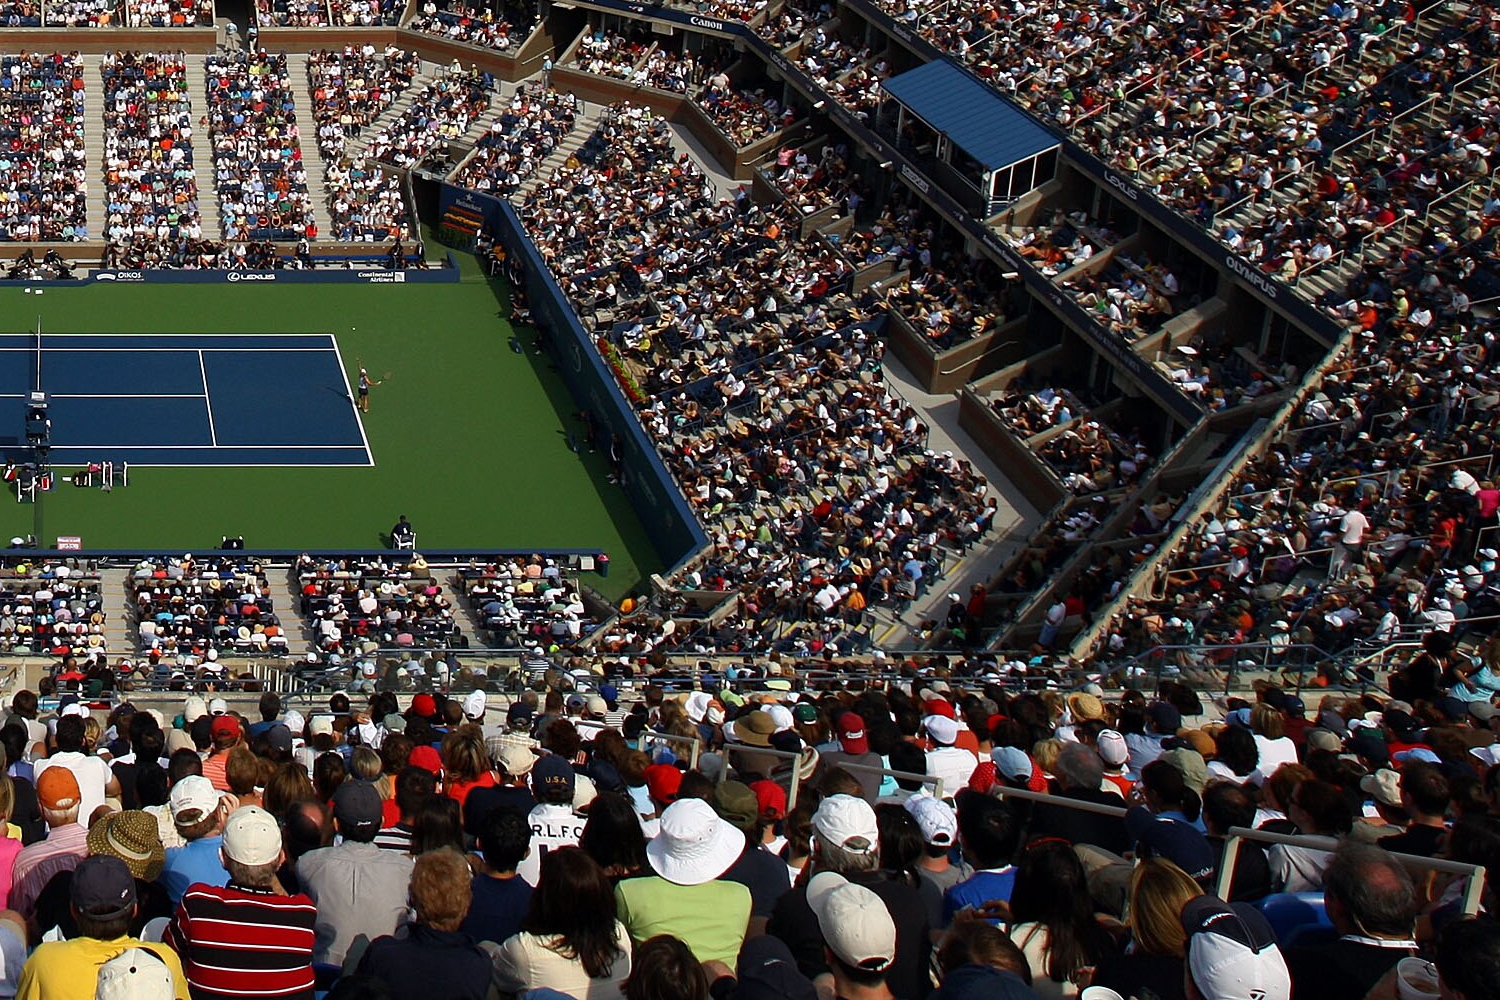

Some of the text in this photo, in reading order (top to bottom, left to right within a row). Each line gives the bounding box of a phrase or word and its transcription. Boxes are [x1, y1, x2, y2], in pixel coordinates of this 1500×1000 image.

[690, 16, 723, 30] Canon
[1104, 170, 1138, 200] LEXUS
[1226, 256, 1278, 298] OLYMPUS
